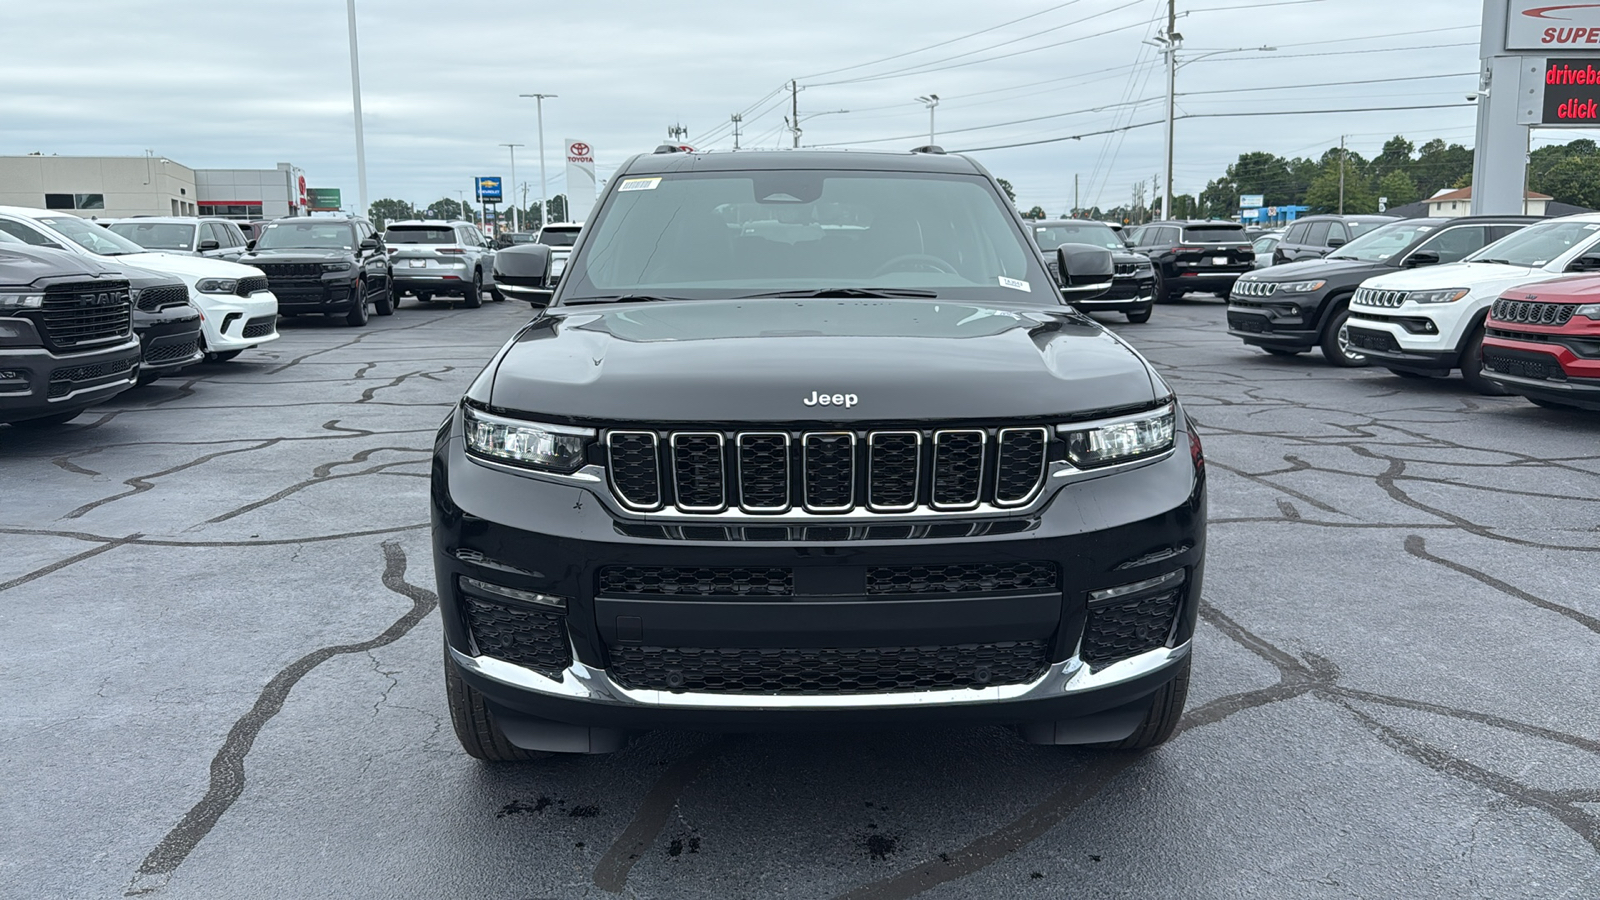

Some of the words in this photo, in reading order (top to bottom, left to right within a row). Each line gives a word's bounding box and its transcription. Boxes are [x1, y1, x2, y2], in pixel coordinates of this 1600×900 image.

[1541, 27, 1600, 44] SUPE
[1557, 98, 1598, 119] click
[80, 292, 122, 306] RAM
[803, 391, 858, 408] Jeep
